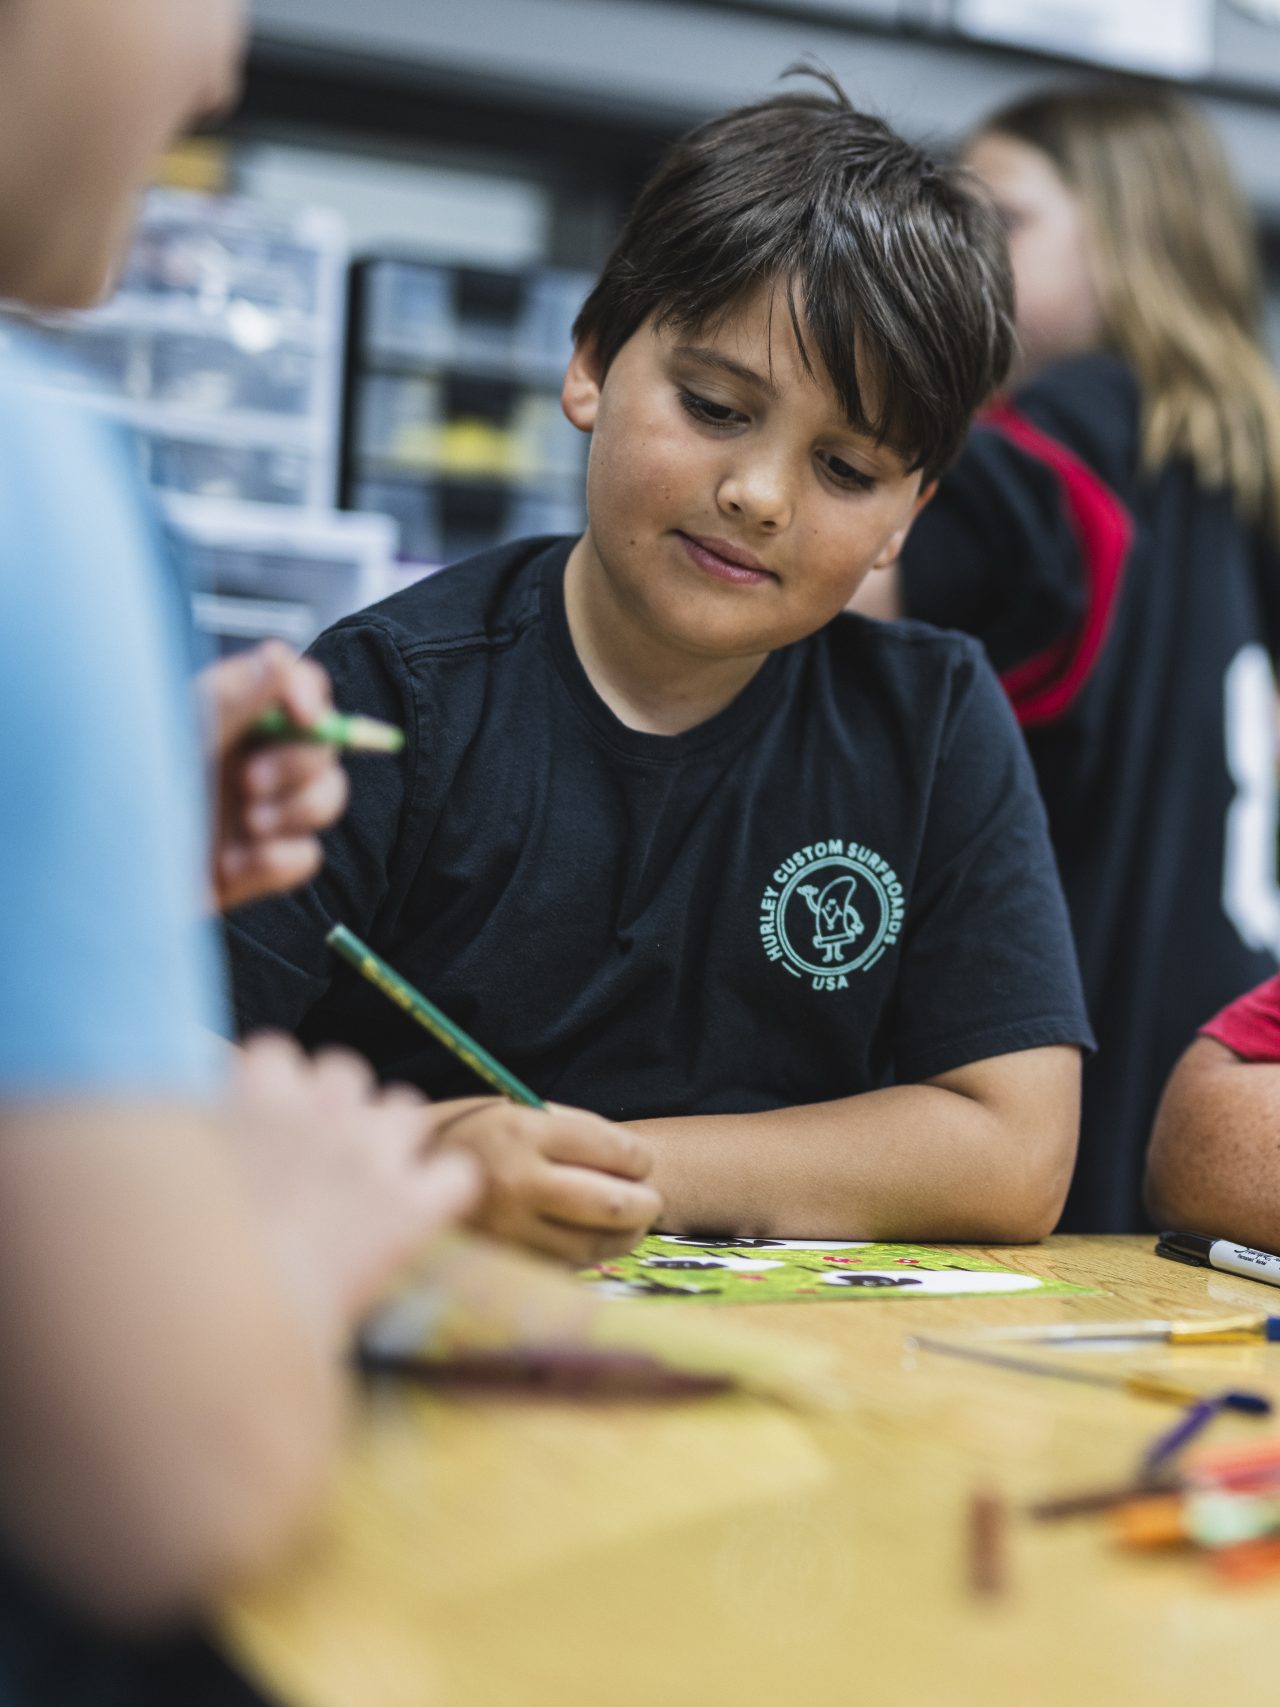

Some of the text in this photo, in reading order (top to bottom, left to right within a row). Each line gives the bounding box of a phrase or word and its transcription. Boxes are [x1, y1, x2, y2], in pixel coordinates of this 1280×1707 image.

[760, 839, 905, 962] HURLEY CUSTOM SURFBOARDS
[811, 975, 849, 991] USA
